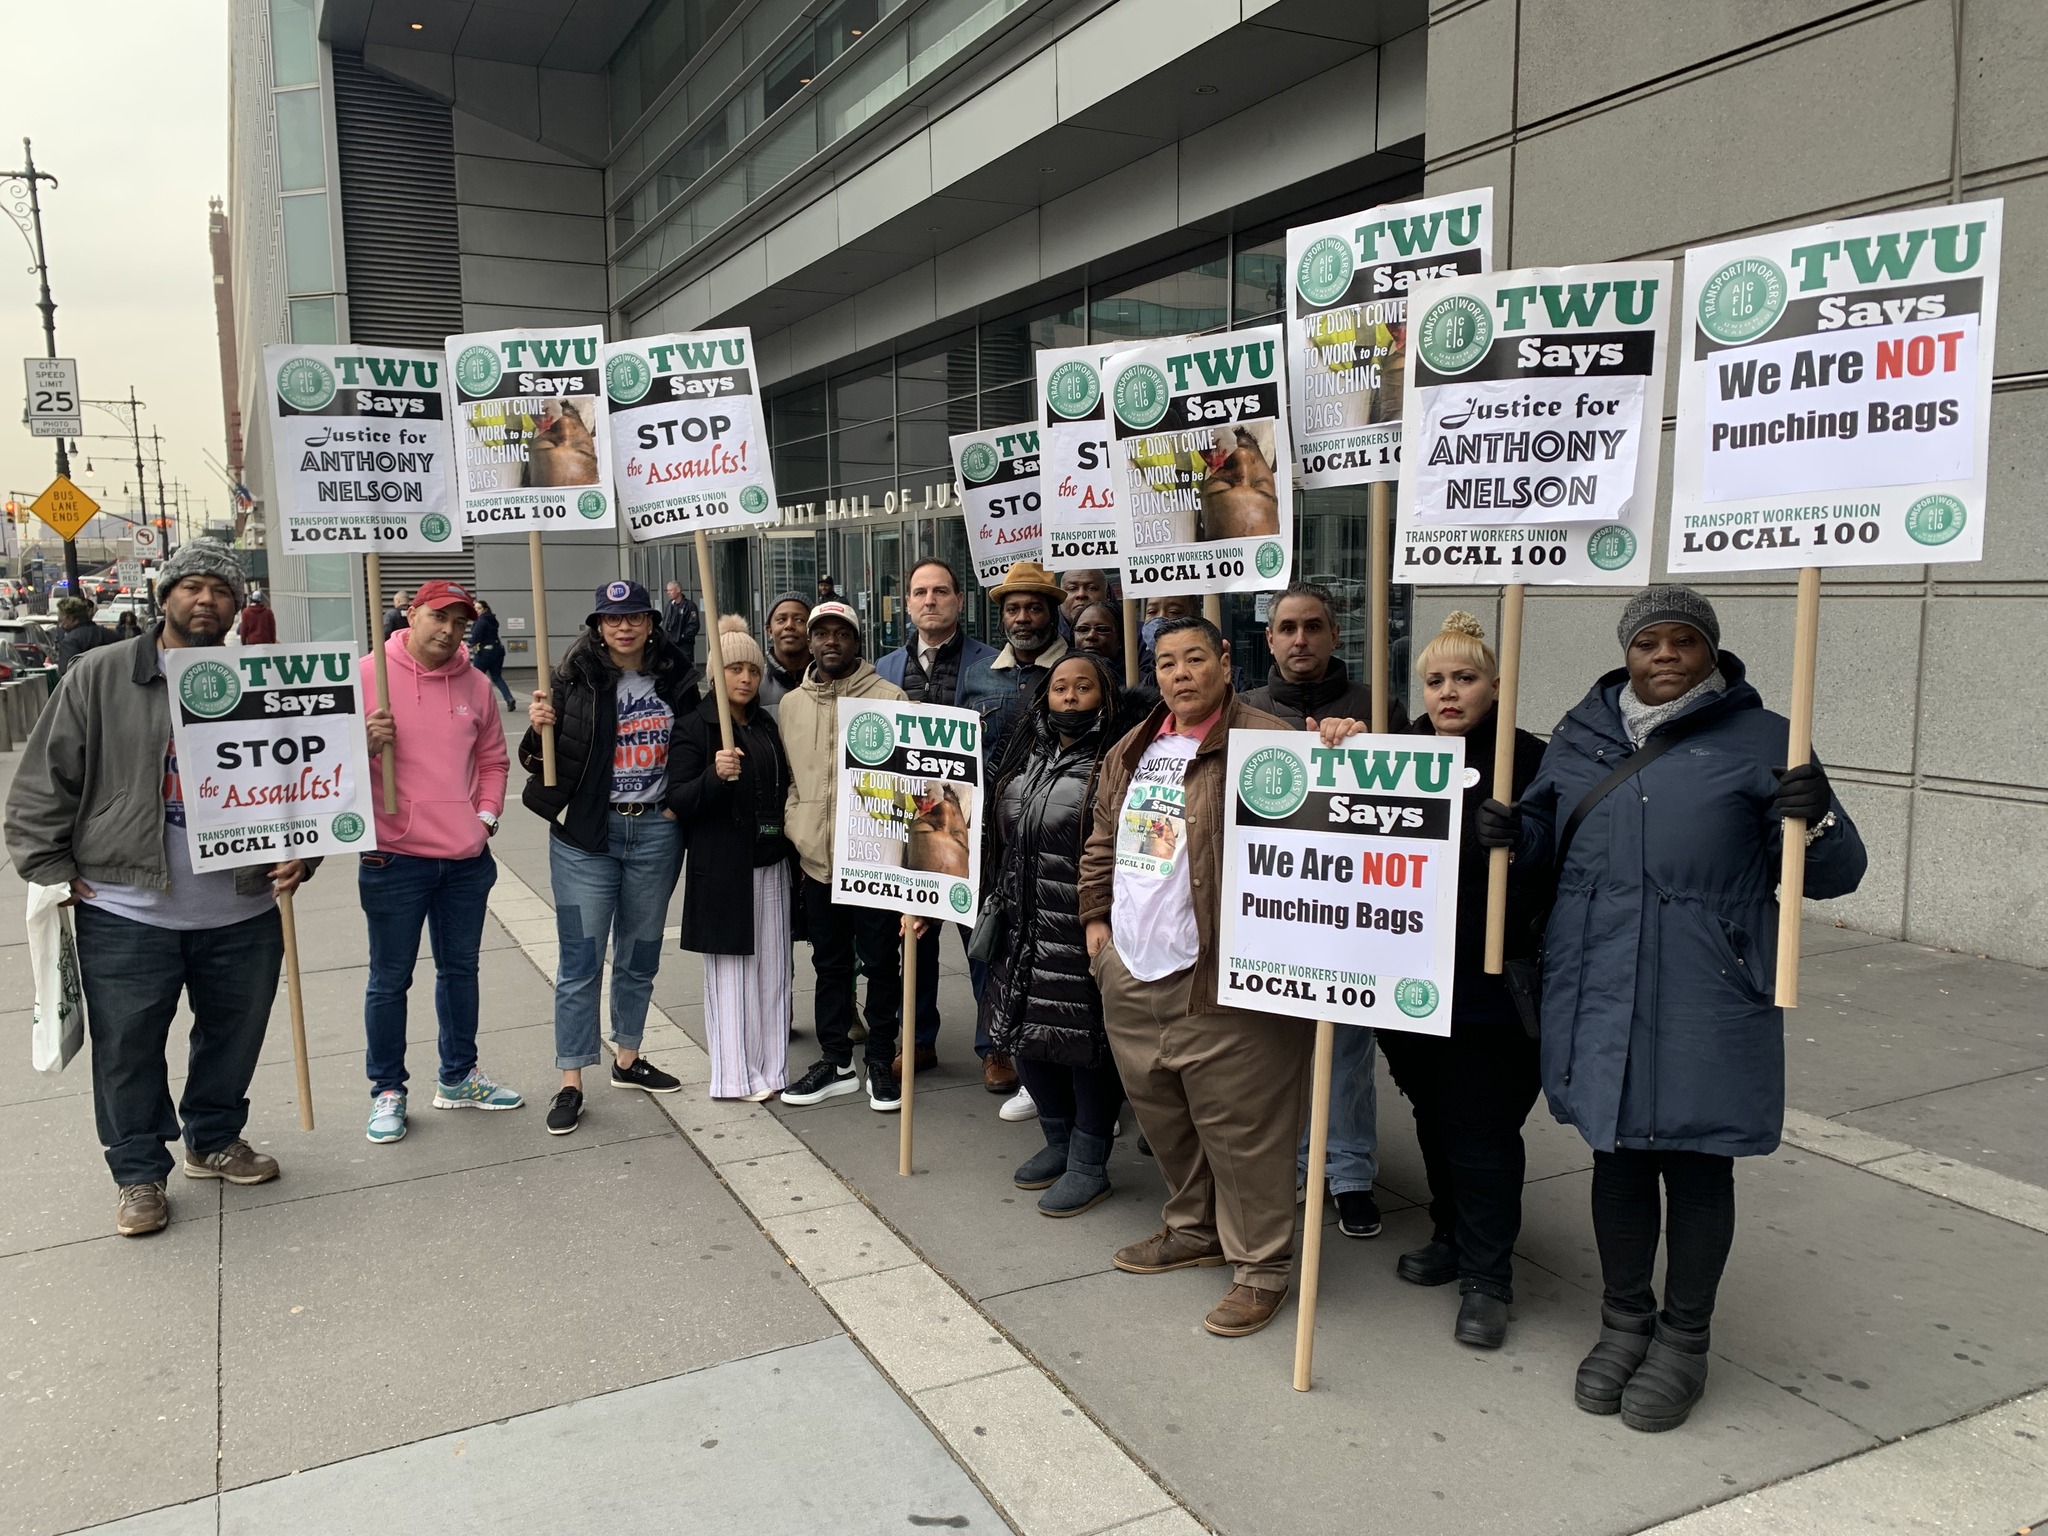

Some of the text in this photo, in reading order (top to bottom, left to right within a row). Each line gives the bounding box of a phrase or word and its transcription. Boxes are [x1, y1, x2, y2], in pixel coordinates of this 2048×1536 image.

[1355, 204, 1482, 263] TWU
[1790, 220, 1987, 292] TWU
[1705, 262, 1778, 318] TRANSPORT WORKERS
[1496, 280, 1658, 331] TWU
[1818, 293, 1946, 331] Says
[1305, 301, 1406, 338] WE DON'T COME
[1424, 299, 1486, 348] TRANSPORT WORKERS
[501, 338, 597, 368] TWU
[648, 339, 744, 373] TWU
[1167, 340, 1275, 391] TWU
[1305, 340, 1387, 369] TO WORK to be
[1518, 338, 1623, 375] Says
[1719, 330, 1964, 400] We Are NOT
[335, 357, 438, 388] TWU
[519, 373, 584, 396] Says
[1305, 365, 1381, 399] PUNCHING
[670, 376, 734, 397] Says
[35, 391, 73, 411] 25
[356, 391, 424, 417] Says
[1186, 394, 1260, 422] Says
[1440, 393, 1620, 430] Justice for
[1305, 401, 1344, 430] BAGS
[1712, 399, 1959, 452] Punching Bags
[305, 427, 426, 447] Justice for
[637, 415, 731, 450] STOP
[996, 431, 1040, 457] TW
[1124, 429, 1217, 460] WE DON'T COME
[1300, 439, 1346, 455] TRANSPORT
[1348, 434, 1389, 450] WORKERS
[467, 444, 529, 466] PUNCHING
[1428, 429, 1627, 466] ANTHONY
[300, 451, 434, 472] ANTHONY
[627, 441, 747, 485] the Assaults!
[1302, 449, 1371, 475] LOCAL
[469, 469, 498, 489] BAGS
[1058, 476, 1078, 498] the
[1127, 466, 1203, 489] TO WORK to be
[53, 491, 74, 501] BUS
[318, 481, 422, 502] NELSON
[466, 495, 565, 508] TRANSPORT WORKERS UNION
[628, 492, 726, 515] TRANSPORT WORKERS UNION
[826, 495, 870, 520] HALL
[885, 489, 911, 514] OF
[1131, 489, 1202, 517] PUNCHING
[1446, 475, 1597, 510] NELSON
[51, 501, 79, 512] LANE
[52, 512, 80, 522] ENDS
[467, 506, 566, 523] LOCAL 100
[631, 502, 728, 529] LOCAL 100
[989, 492, 1041, 518] STO
[1684, 503, 1881, 528] TRANSPORT WORKERS UNION
[289, 516, 407, 525] TRANSPORT WORKERS UNION
[980, 524, 992, 539] the
[1134, 519, 1172, 545] BAGS
[291, 527, 407, 541] LOCAL 100
[1050, 530, 1097, 541] TRANSPORT
[1405, 529, 1568, 543] TRANSPORT WORKERS UNION
[1683, 521, 1880, 553] LOCAL 100
[979, 556, 1009, 567] TRANSPORT
[1010, 551, 1037, 561] WORKERS
[1051, 541, 1118, 558] LOCAL
[1127, 547, 1244, 566] TRANSPORT WORKERS UNION
[1405, 546, 1566, 565] LOCAL 100
[1130, 560, 1244, 584] LOCAL 100
[240, 653, 351, 687] TWU
[264, 692, 335, 715] Says
[896, 714, 976, 752] TWU
[216, 736, 325, 769] STOP
[906, 751, 965, 778] Says
[1142, 758, 1186, 771] JUSTICE
[850, 771, 927, 796] WE DON'T COME
[1244, 750, 1301, 791] TRANSPORT WORKERS
[1311, 748, 1453, 793] TWU
[199, 777, 219, 799] the
[222, 764, 342, 809] Assaults!
[617, 783, 642, 791] 100
[1152, 801, 1180, 815] Says
[1329, 796, 1424, 834] Says
[197, 819, 317, 842] TRANSPORT WORKERS UNION
[849, 816, 909, 843] PUNCHING
[199, 830, 319, 859] LOCAL 100
[849, 839, 881, 861] BAGS
[841, 867, 939, 889] TRANSPORT WORKERS UNION
[1141, 862, 1155, 871] 100
[1248, 843, 1428, 888] We Are NOT
[841, 879, 939, 904] LOCAL 100
[1242, 892, 1424, 935] Punching Bags
[1230, 956, 1376, 986] TRANSPORT WORKERS UNION
[1229, 972, 1376, 1008] LOCAL 100
